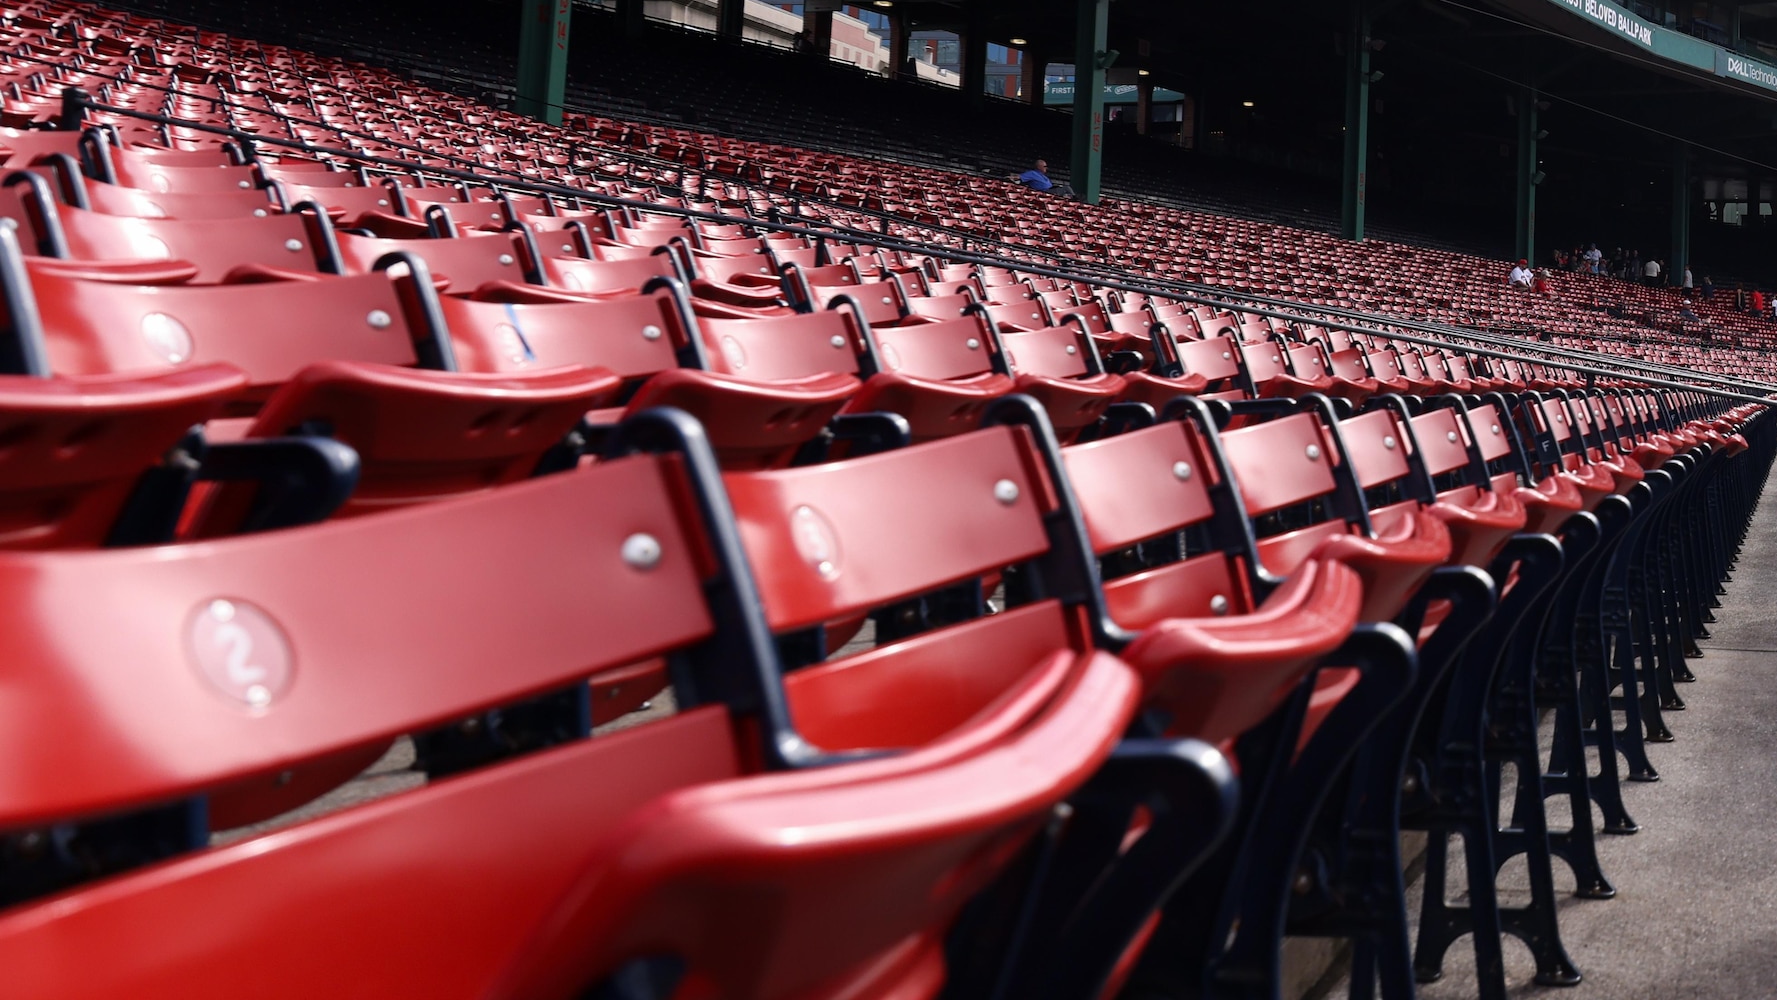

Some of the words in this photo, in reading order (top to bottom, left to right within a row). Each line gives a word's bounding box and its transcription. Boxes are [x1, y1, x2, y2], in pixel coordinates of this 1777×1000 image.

[1618, 13, 1652, 46] BALLPARK
[1541, 439, 1550, 452] F
[213, 624, 263, 683] 2
